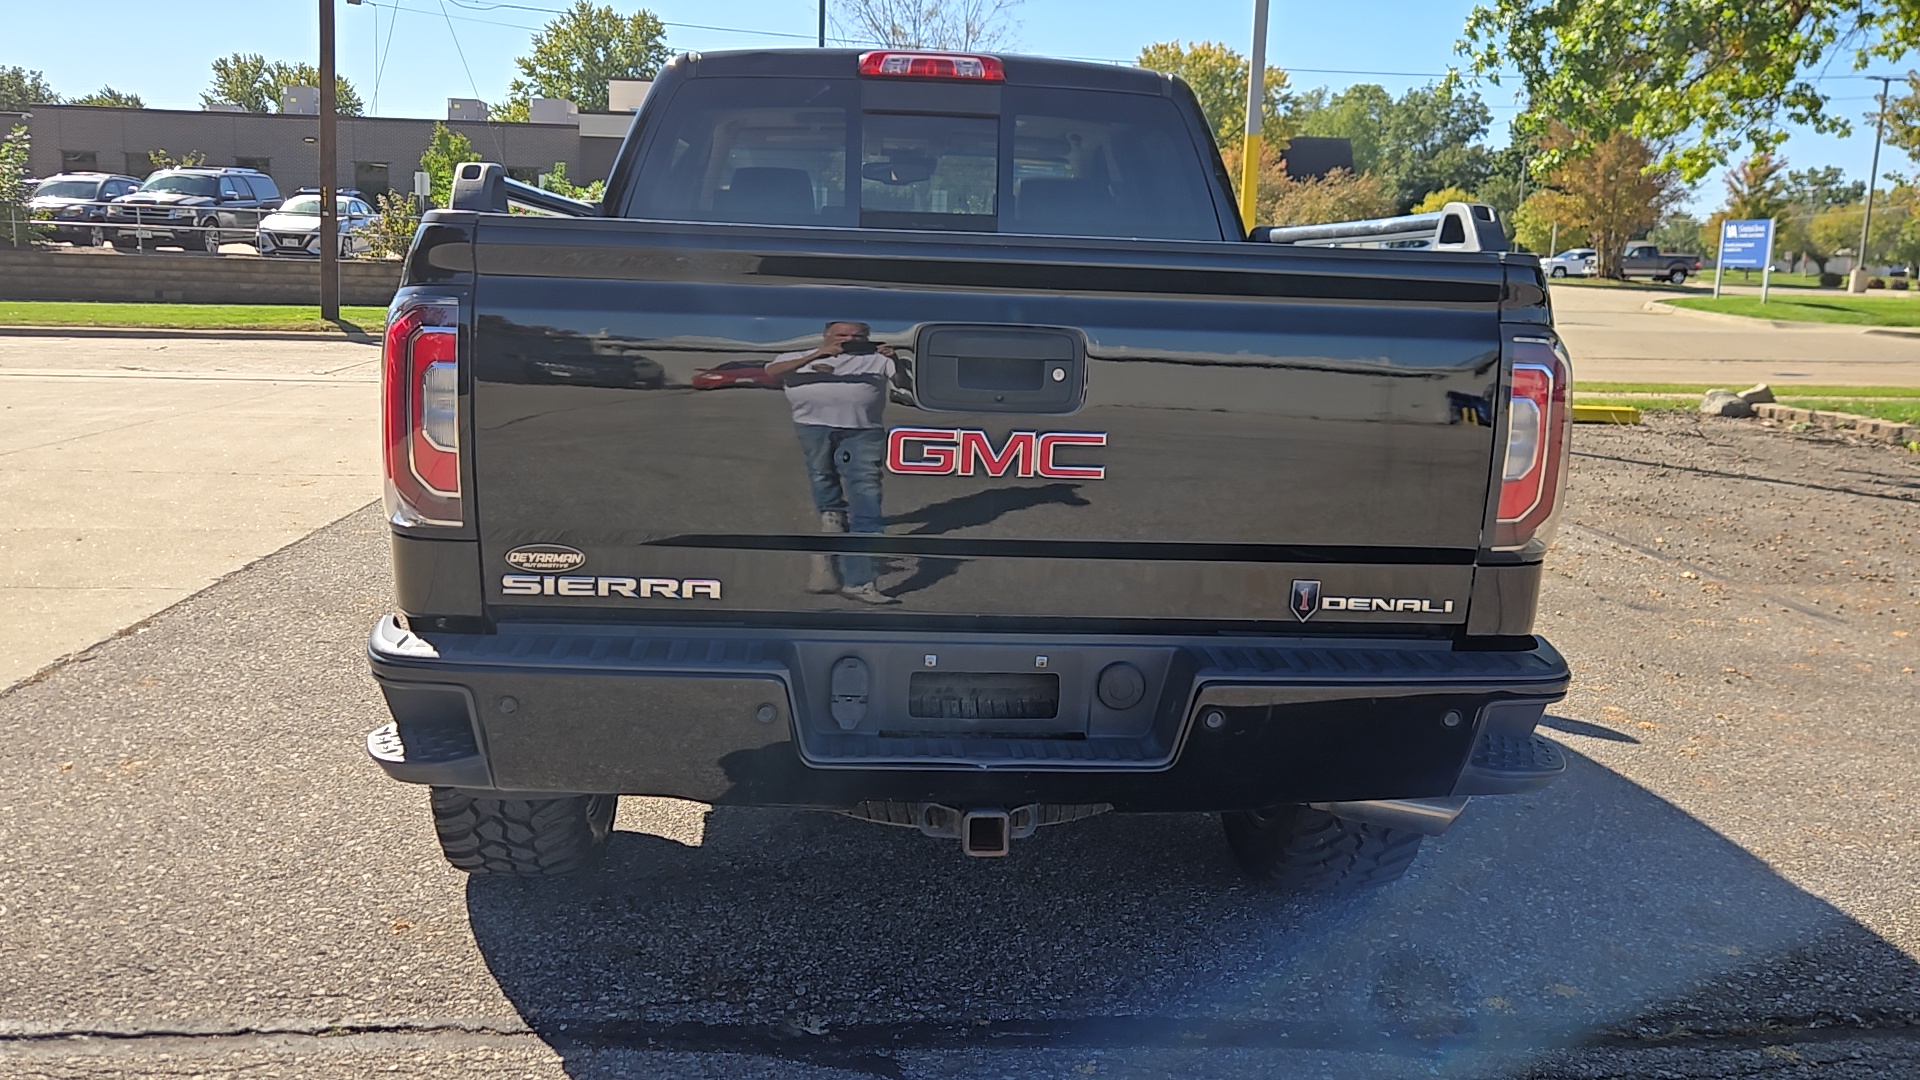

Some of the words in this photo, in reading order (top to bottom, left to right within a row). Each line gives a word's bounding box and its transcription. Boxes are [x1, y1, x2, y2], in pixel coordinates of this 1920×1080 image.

[886, 427, 1107, 479] GMC
[509, 552, 582, 563] DEYARMAN
[502, 574, 722, 599] SIERRA
[1321, 596, 1454, 613] DENALI
